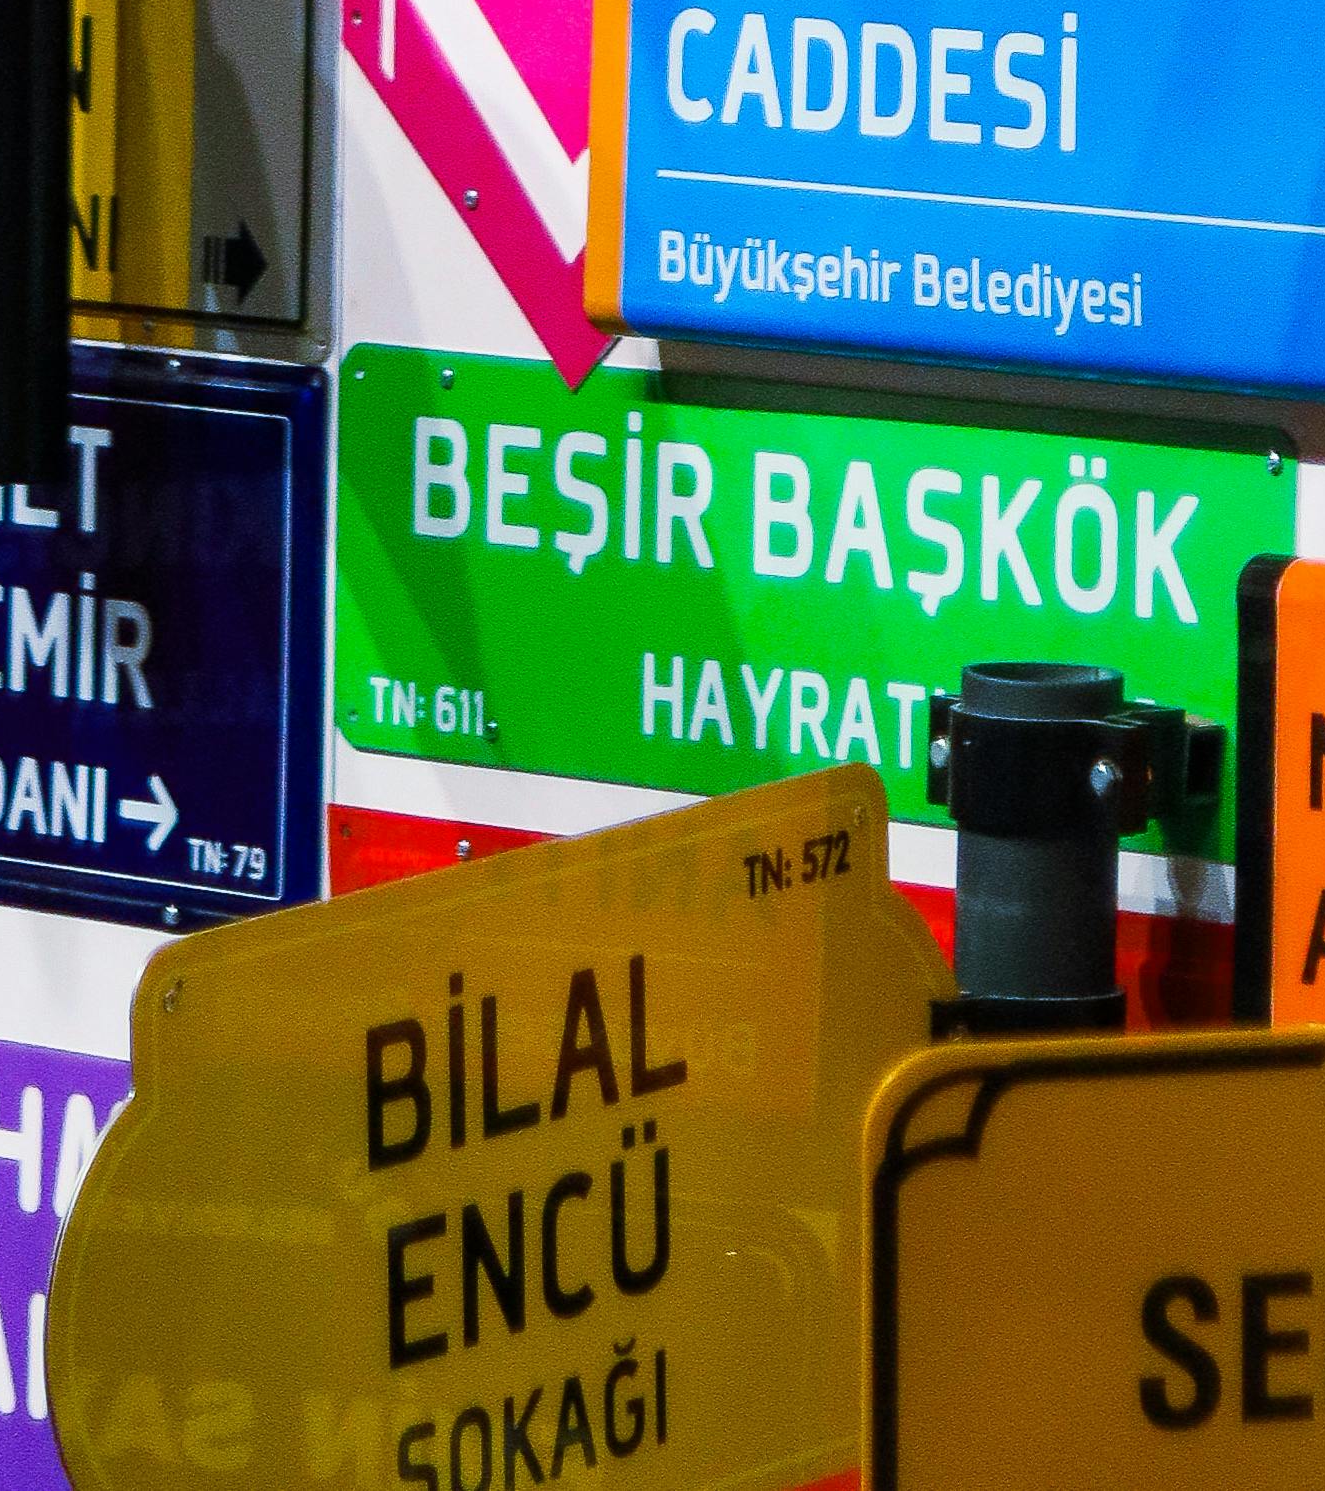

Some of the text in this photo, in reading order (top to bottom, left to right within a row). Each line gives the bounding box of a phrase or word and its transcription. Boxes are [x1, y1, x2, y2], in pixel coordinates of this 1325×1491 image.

[666, 10, 1081, 153] CADDESİ
[658, 230, 1146, 332] Büyükşehir Belediyesi
[411, 408, 1202, 627] BEŞİR BAŞKÖK
[368, 674, 427, 730] TN:
[434, 685, 487, 737] 611
[233, 843, 266, 881] 79
[742, 829, 850, 898] TN: 572
[364, 952, 689, 1174] BİLAL
[387, 1119, 673, 1371] ENCÜ
